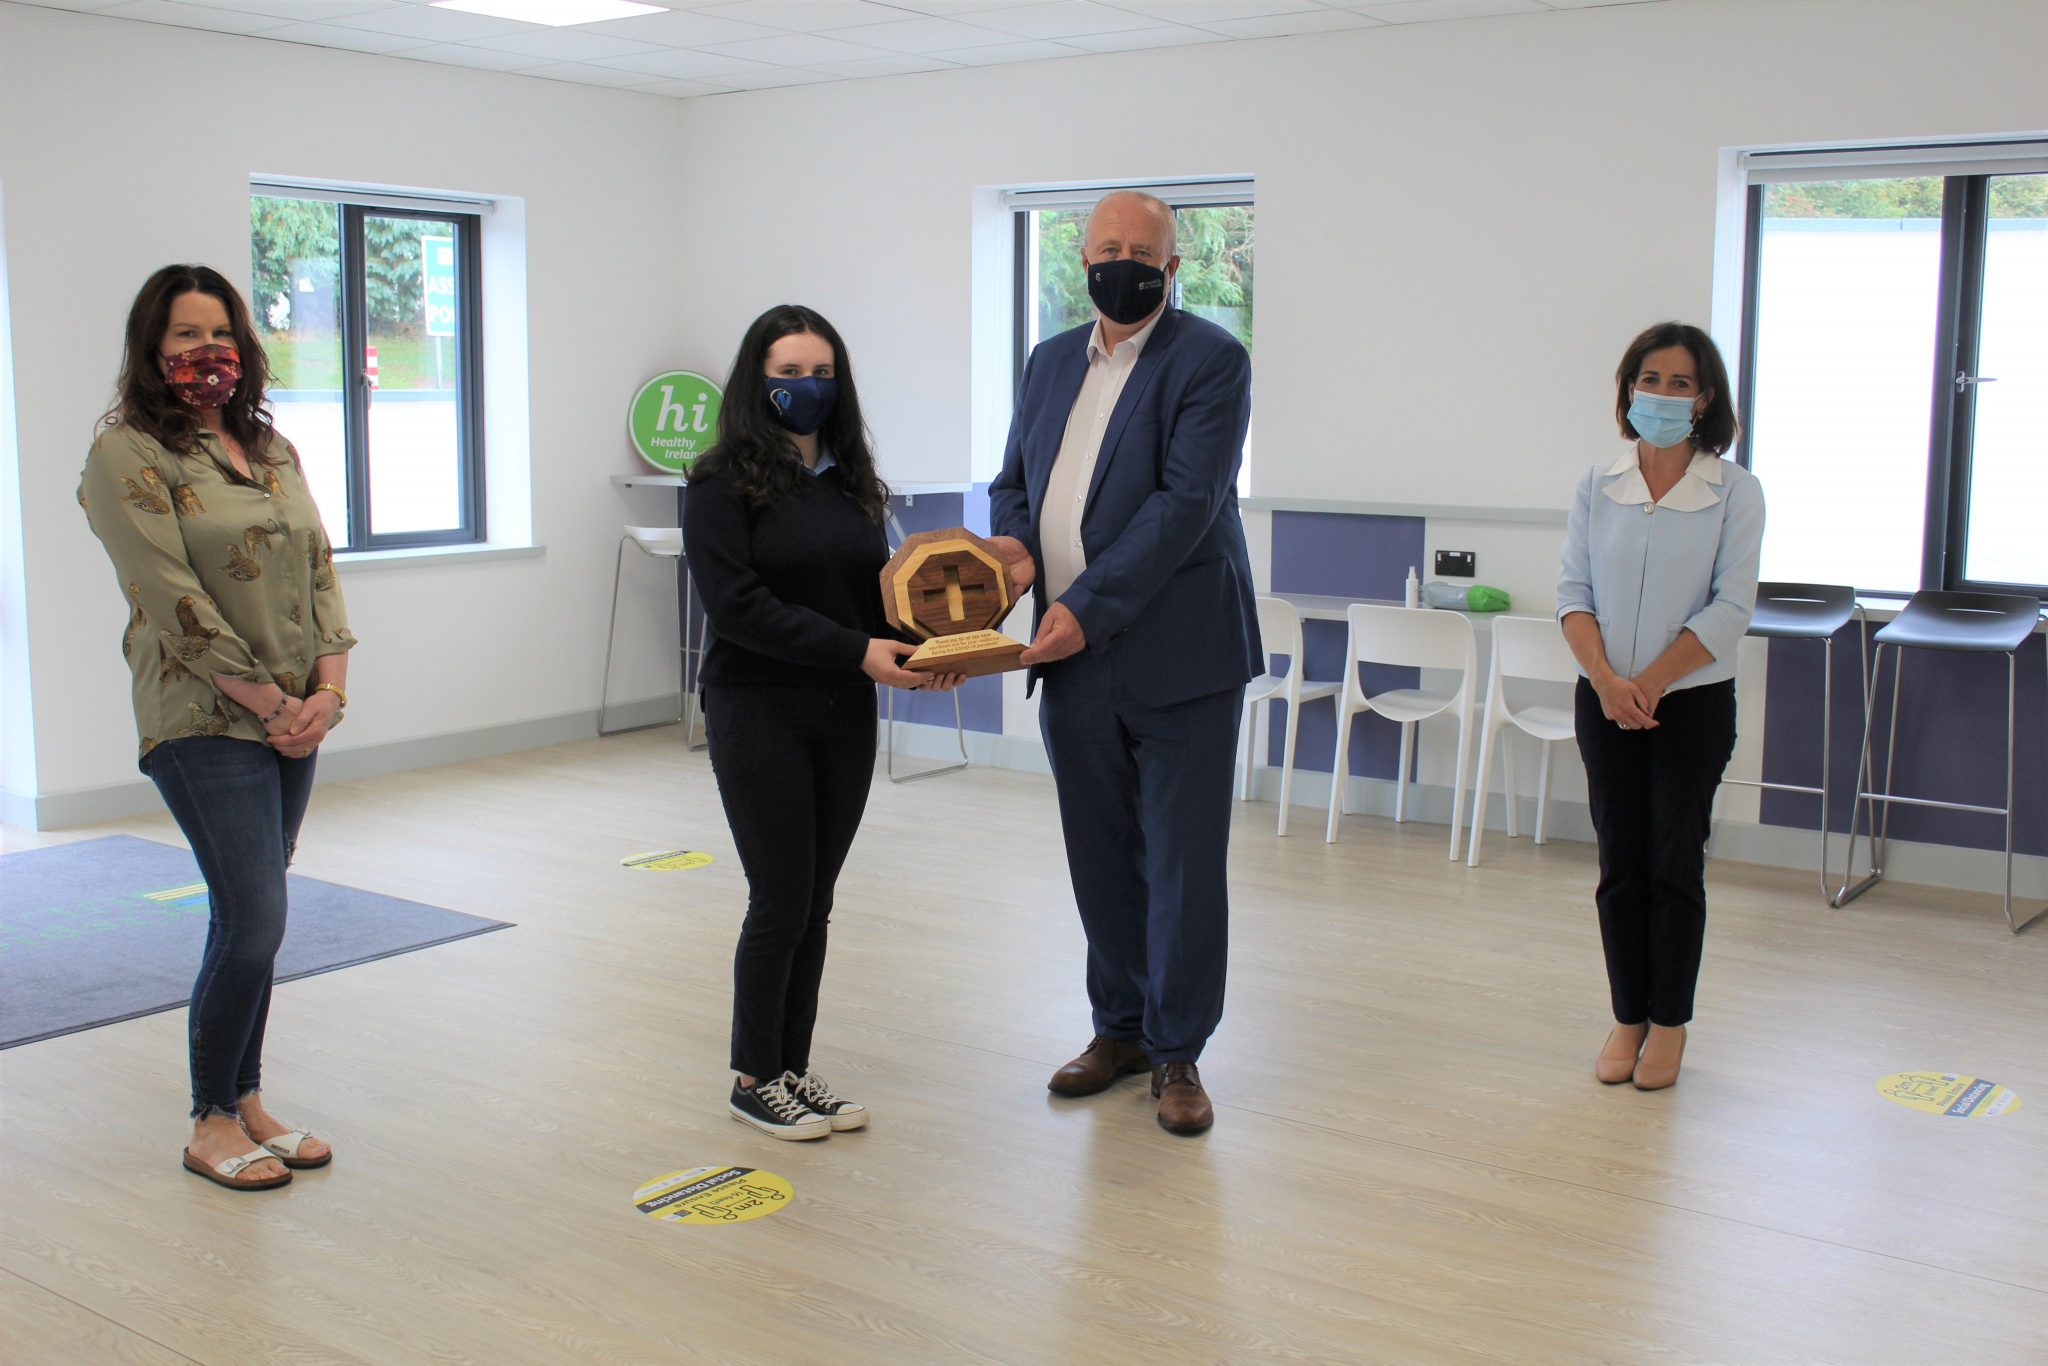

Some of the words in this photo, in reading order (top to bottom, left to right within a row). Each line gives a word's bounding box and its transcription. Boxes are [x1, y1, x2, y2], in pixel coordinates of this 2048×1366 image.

[656, 385, 709, 433] hi
[651, 437, 697, 449] Healthy
[664, 449, 698, 459] Irelan
[704, 1169, 742, 1186] Social
[645, 1181, 710, 1207] Distancing
